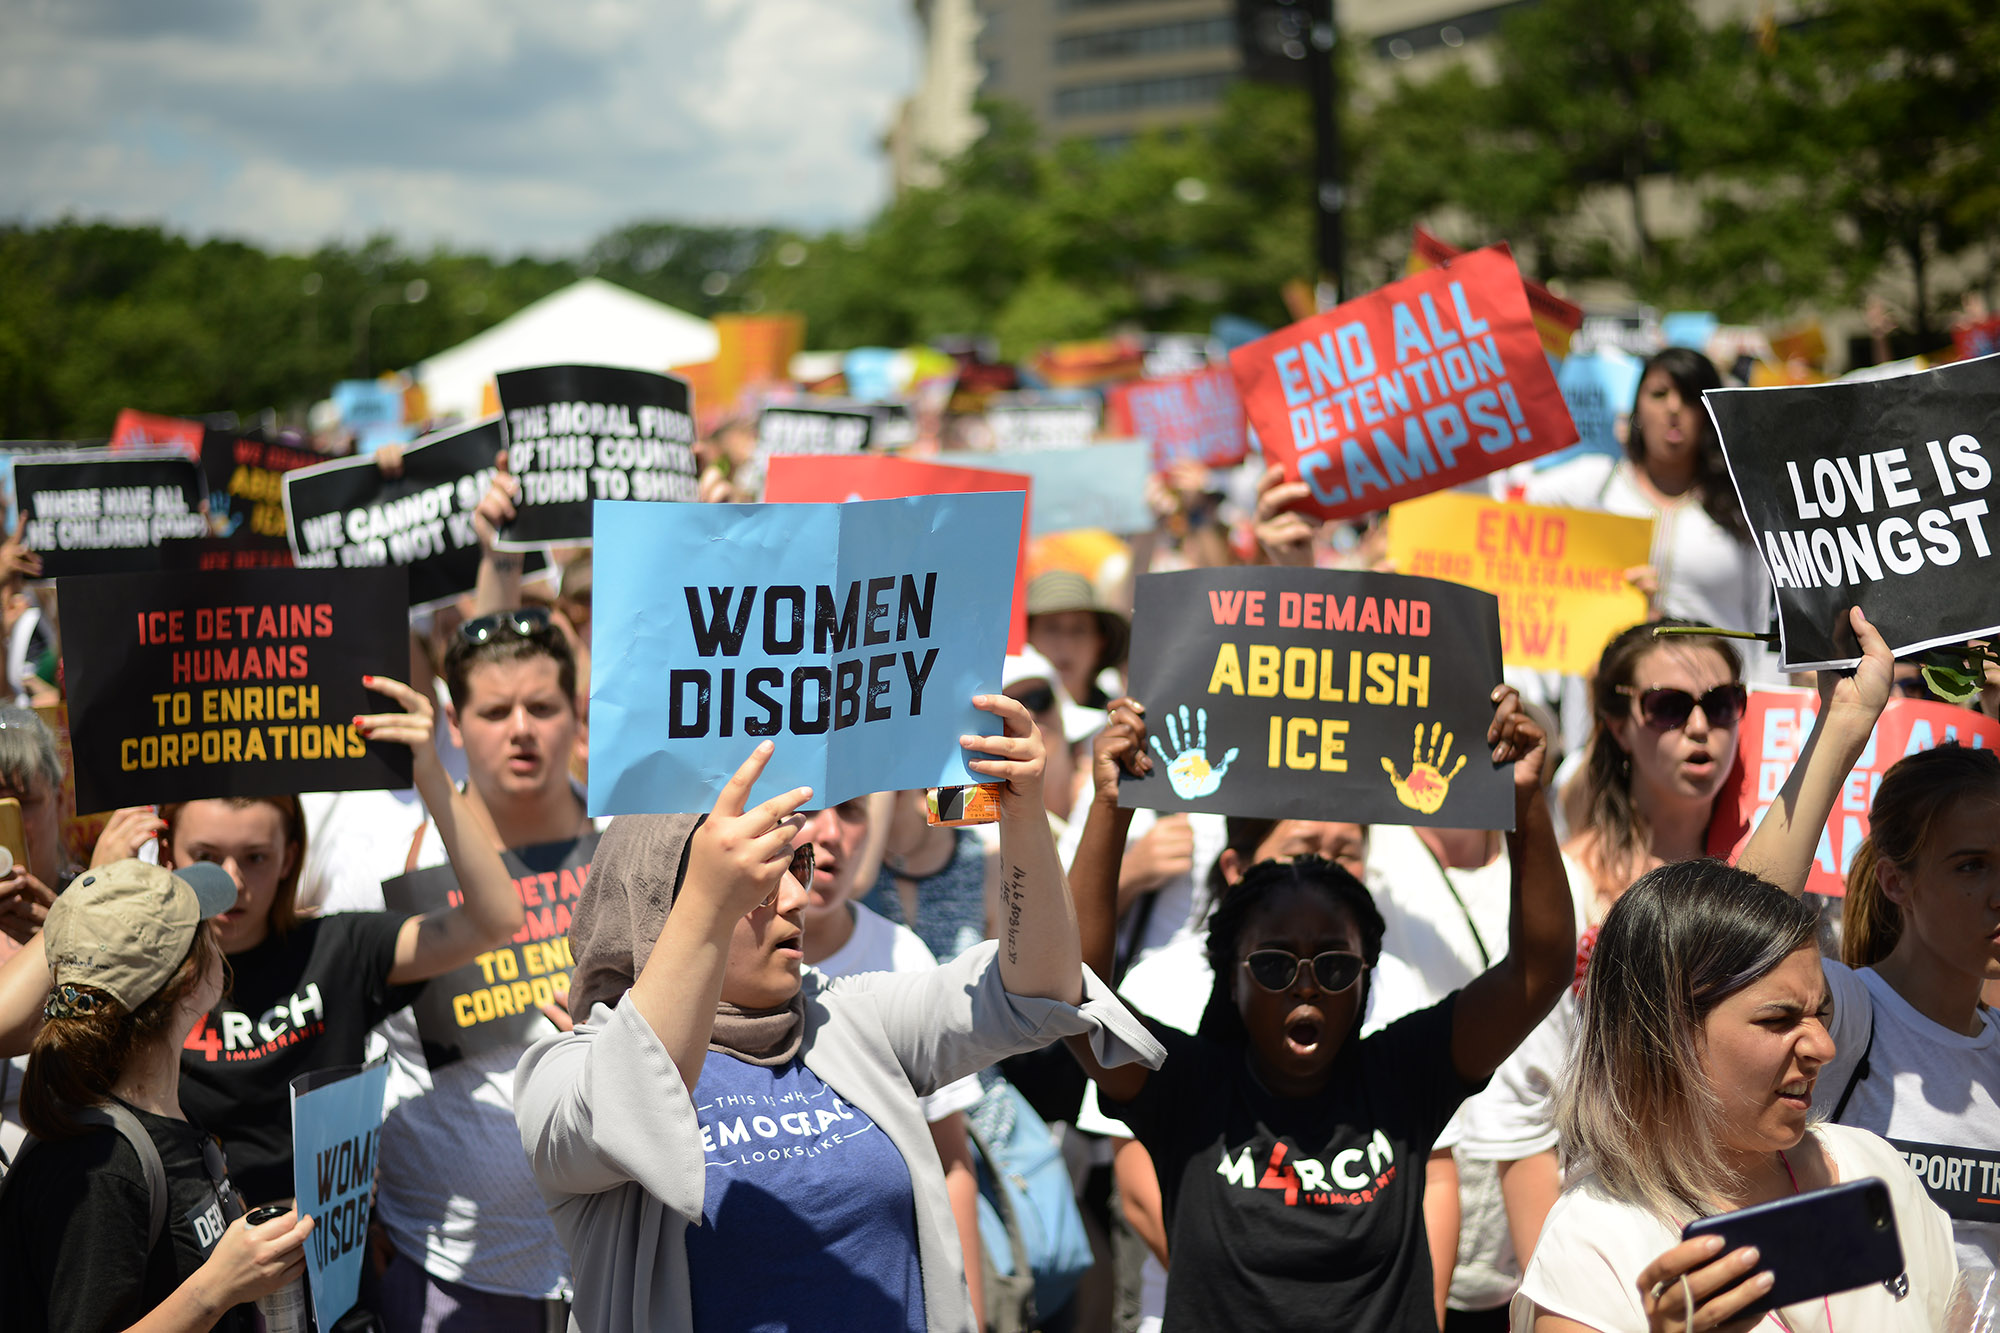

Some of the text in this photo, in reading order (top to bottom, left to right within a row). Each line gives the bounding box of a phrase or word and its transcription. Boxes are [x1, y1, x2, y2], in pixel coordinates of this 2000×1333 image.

[1273, 321, 1377, 406] END
[1392, 281, 1490, 363] ALL
[1288, 335, 1505, 450] DETENTION
[508, 405, 548, 441] THE
[548, 400, 638, 438] MORAL
[1297, 382, 1533, 507] CAMPS!
[508, 437, 536, 475] OF
[536, 433, 595, 471] THIS
[1786, 434, 1992, 520] LOVE IS
[32, 485, 190, 521] WHERE HAVE ALL
[522, 466, 588, 506] TORN
[590, 464, 630, 501] TO
[26, 519, 57, 551] HE
[56, 514, 150, 551] CHILDREN
[301, 510, 346, 553] WE
[345, 481, 455, 544] CANNOT
[388, 517, 446, 566] NOT
[1475, 508, 1567, 561] END
[1764, 499, 1992, 589] AMONGST
[138, 603, 333, 646] ICE DETAINS
[683, 571, 938, 658] WOMEN
[1208, 589, 1432, 637] WE DEMAND
[172, 644, 308, 684] HUMANS
[1207, 642, 1431, 708] ABOLISH
[152, 684, 320, 728] TO ENRICH
[668, 647, 940, 740] DISOBEY
[121, 723, 366, 772] CORPORATIONS
[1268, 715, 1350, 772] ICE
[474, 948, 519, 984] TO
[183, 982, 323, 1062] 4RCH
[699, 1097, 855, 1153] EMOCRAC
[715, 1094, 756, 1109] THIS
[763, 1095, 776, 1107] IS
[740, 1133, 843, 1166] LOOKS LIKE
